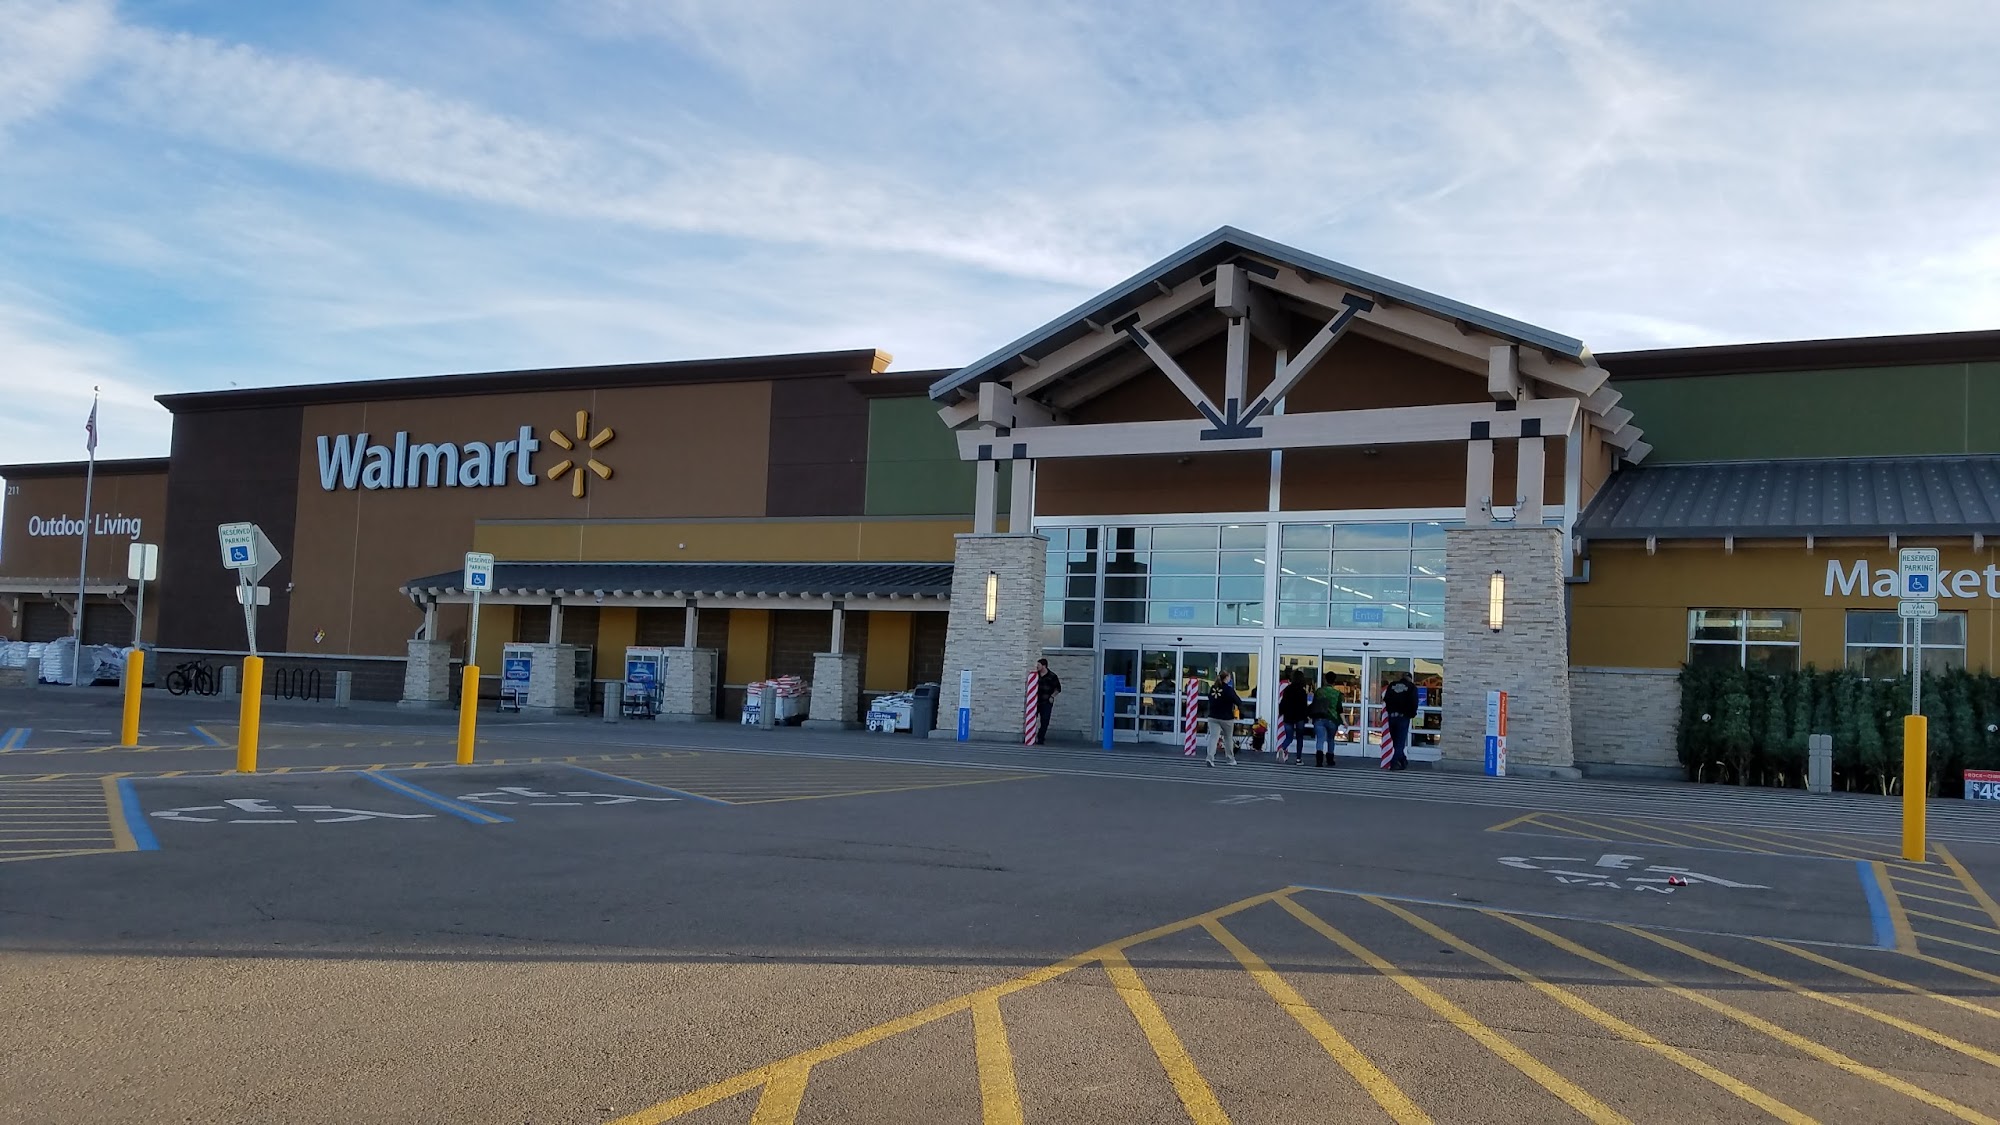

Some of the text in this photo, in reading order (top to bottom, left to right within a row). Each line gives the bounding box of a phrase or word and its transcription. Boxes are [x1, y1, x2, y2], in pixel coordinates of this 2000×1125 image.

[316, 425, 539, 491] Walmart
[7, 486, 20, 495] 211
[28, 513, 142, 539] Outdoo Living
[222, 528, 250, 536] RESERVED
[1902, 554, 1936, 562] RESERVED
[1904, 564, 1934, 572] PARKING
[1824, 559, 2000, 598] Maket
[1355, 610, 1380, 620] Enter
